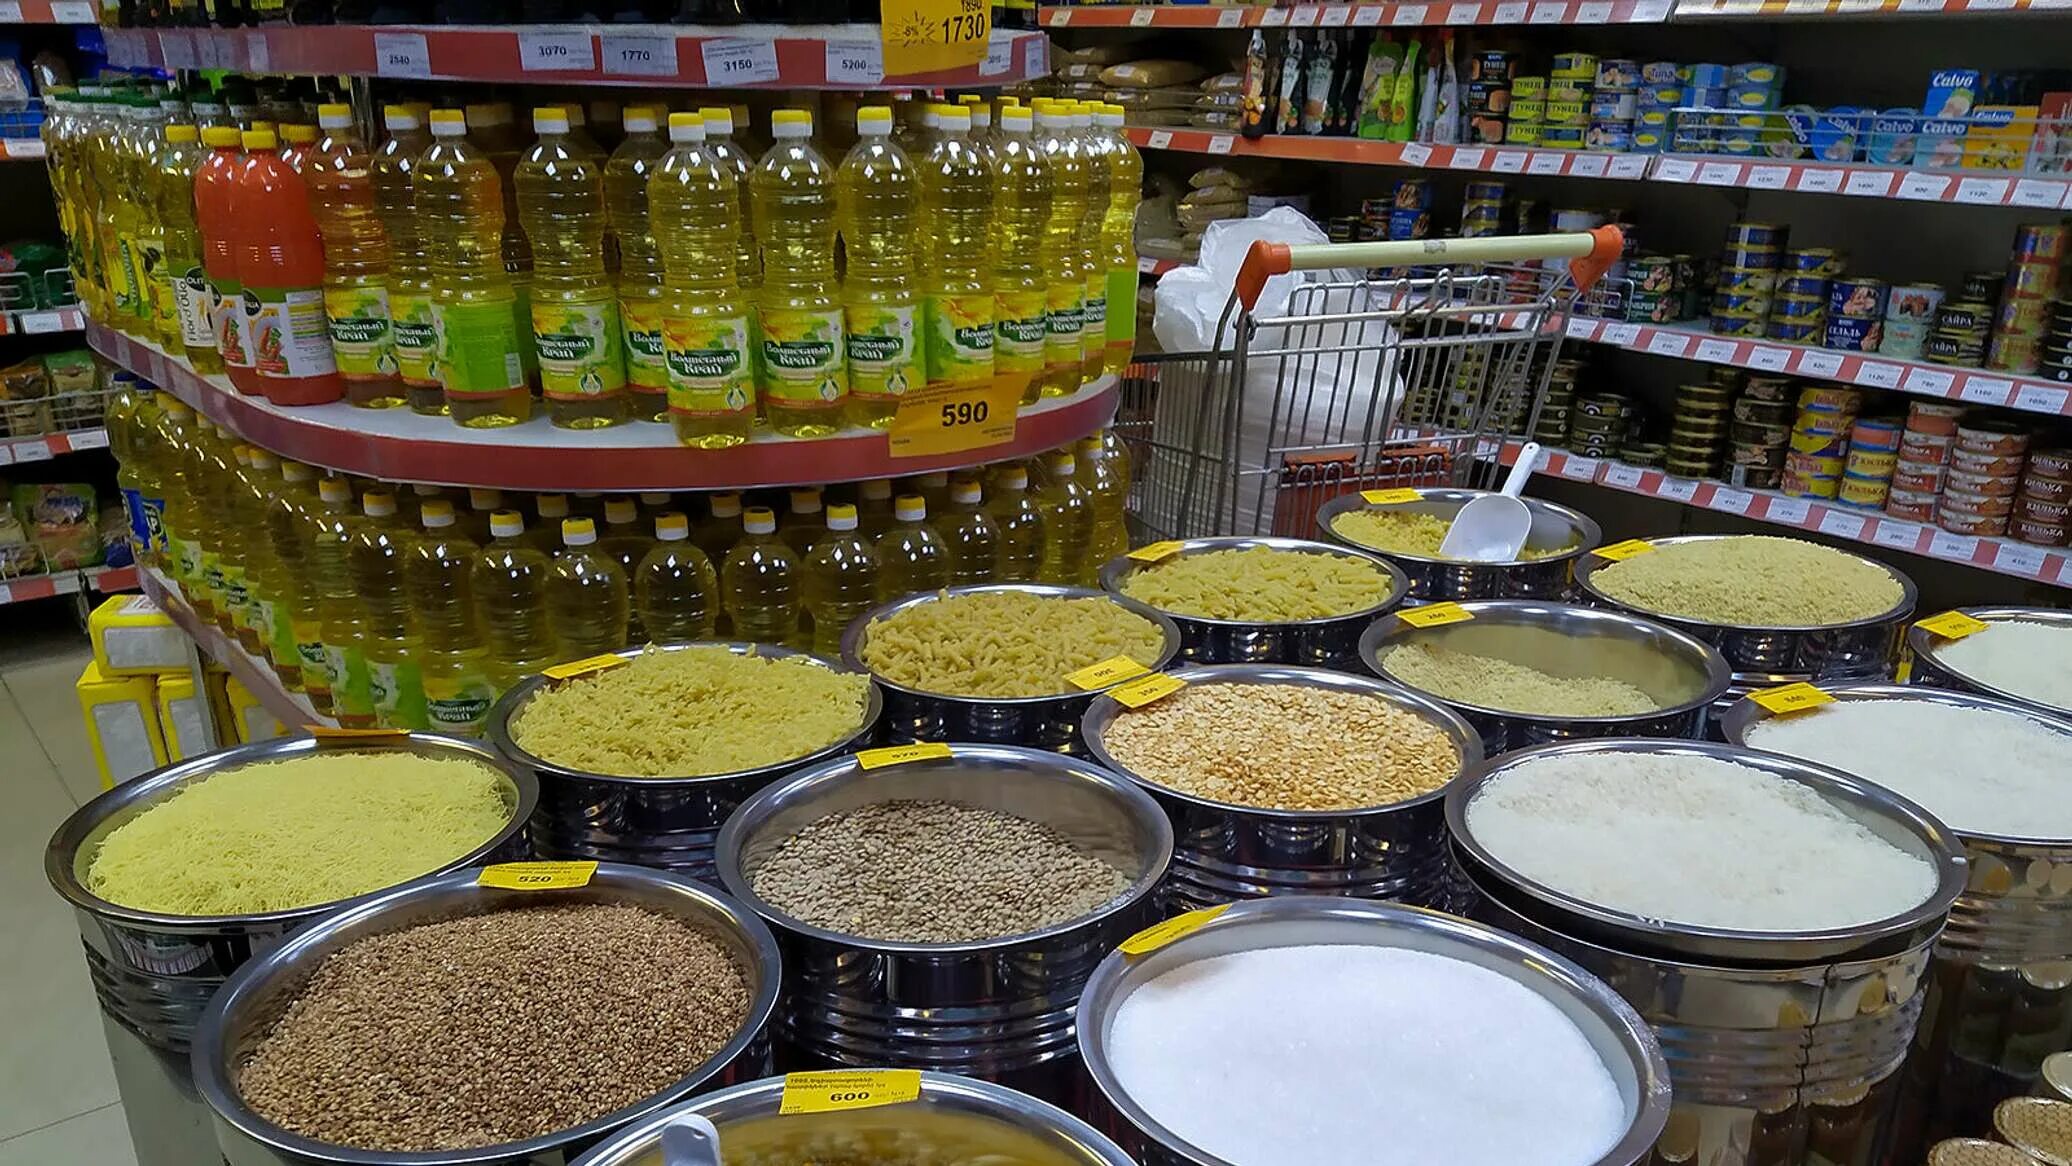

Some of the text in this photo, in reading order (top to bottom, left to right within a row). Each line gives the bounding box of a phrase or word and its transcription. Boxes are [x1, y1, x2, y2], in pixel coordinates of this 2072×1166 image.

[942, 13, 985, 44] 1730
[621, 50, 651, 61] 1770
[723, 59, 753, 73] 3150
[841, 59, 867, 70] 5200
[1932, 73, 1974, 88] Calvo
[1875, 120, 1915, 133] Calvo
[1922, 120, 1966, 135] Calvo
[1941, 313, 1972, 326] САЙРА
[1828, 326, 1861, 338] СЕЛЬДЬ
[767, 342, 831, 356] Волшебный
[671, 351, 737, 366] Волшебный
[780, 353, 816, 367] Край
[684, 362, 723, 376] Край
[941, 400, 988, 427] 590
[2021, 523, 2064, 538] КИЛЬКА
[518, 875, 551, 883] 520
[830, 1091, 870, 1103] 600
